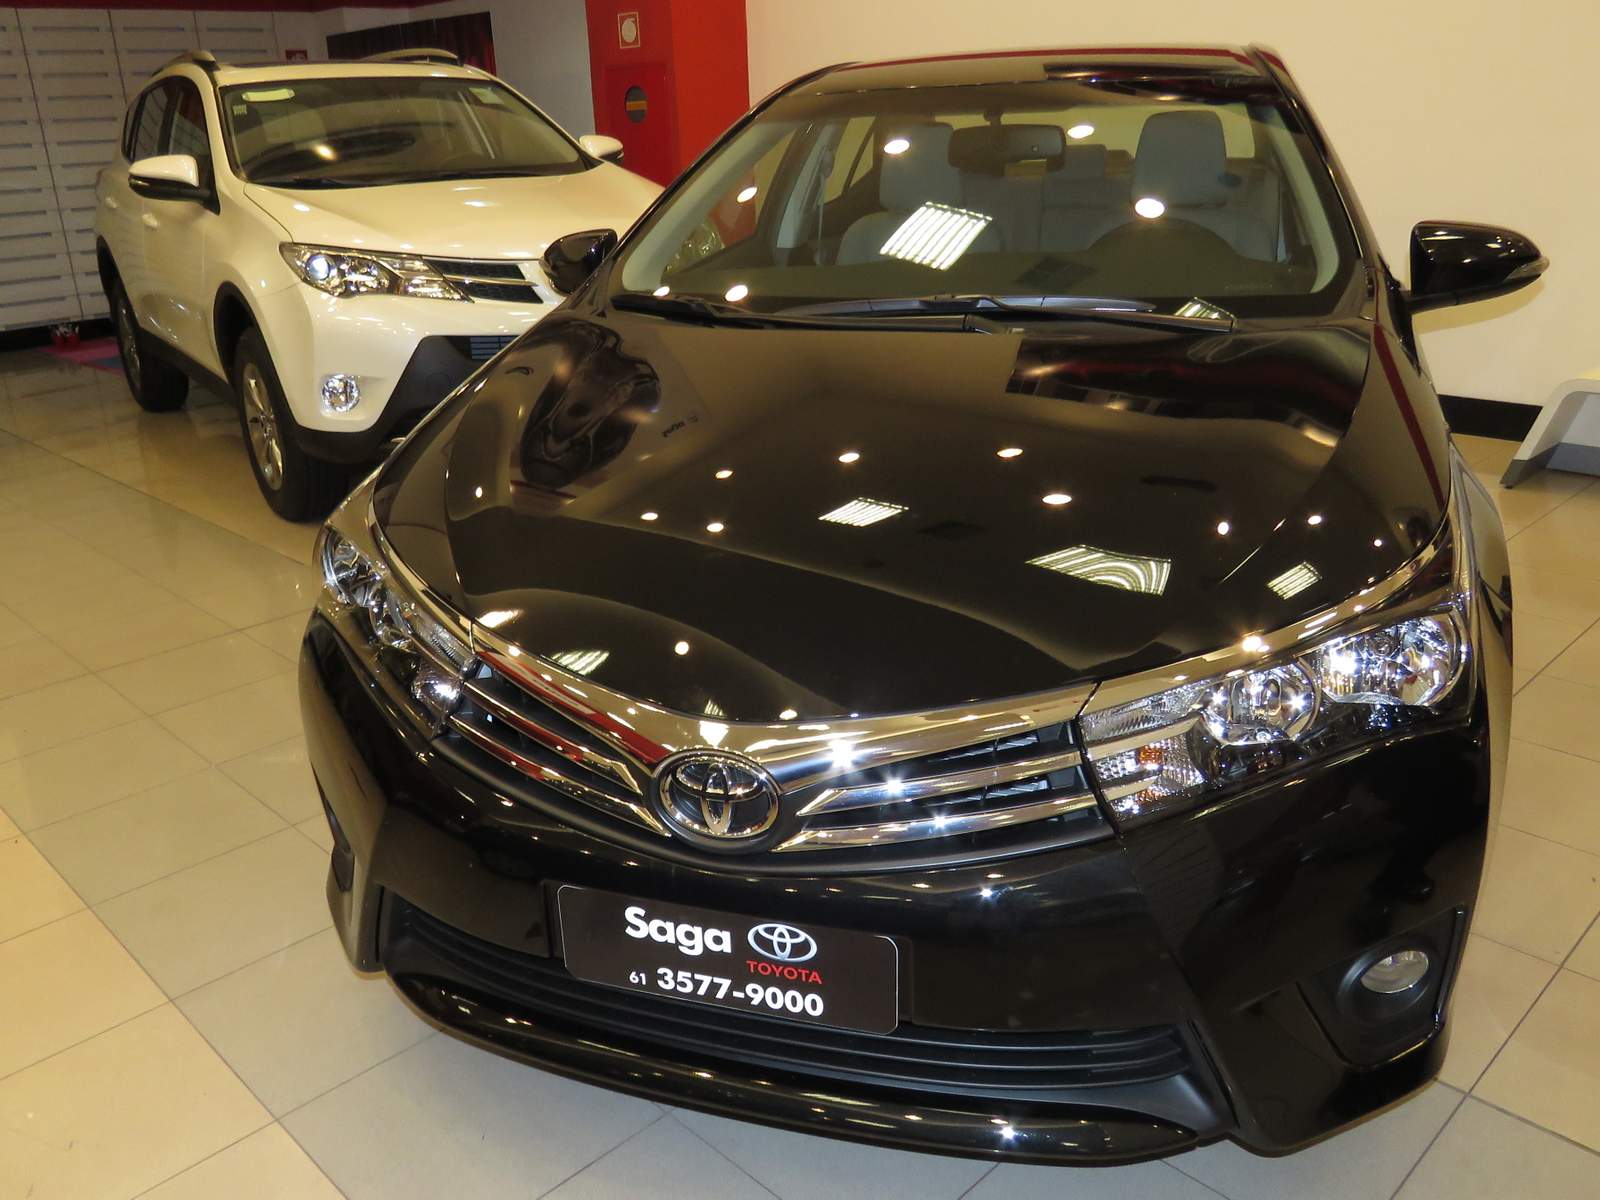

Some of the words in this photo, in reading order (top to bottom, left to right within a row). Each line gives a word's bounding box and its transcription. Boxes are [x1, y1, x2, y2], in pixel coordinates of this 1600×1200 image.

[624, 906, 732, 956] Saga
[628, 971, 648, 986] 61
[656, 967, 824, 1017] 3577-9000
[748, 960, 823, 985] TOYOTA
